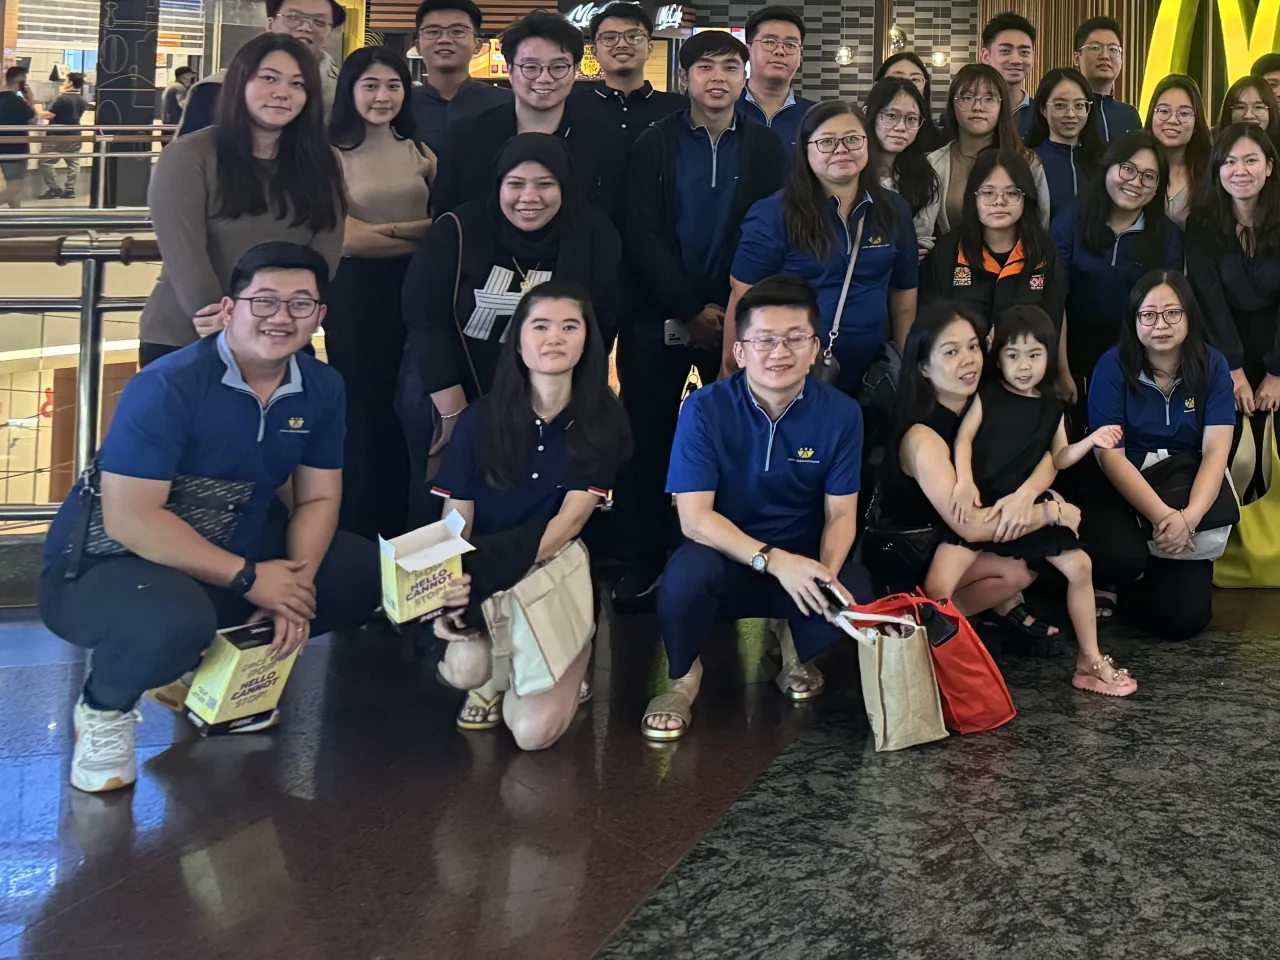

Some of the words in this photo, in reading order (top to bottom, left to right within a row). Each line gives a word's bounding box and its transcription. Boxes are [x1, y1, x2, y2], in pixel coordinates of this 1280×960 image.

[405, 572, 454, 602] CANNOT
[411, 569, 448, 592] HELLO
[230, 676, 280, 701] CANNOT
[240, 671, 277, 690] HELLO
